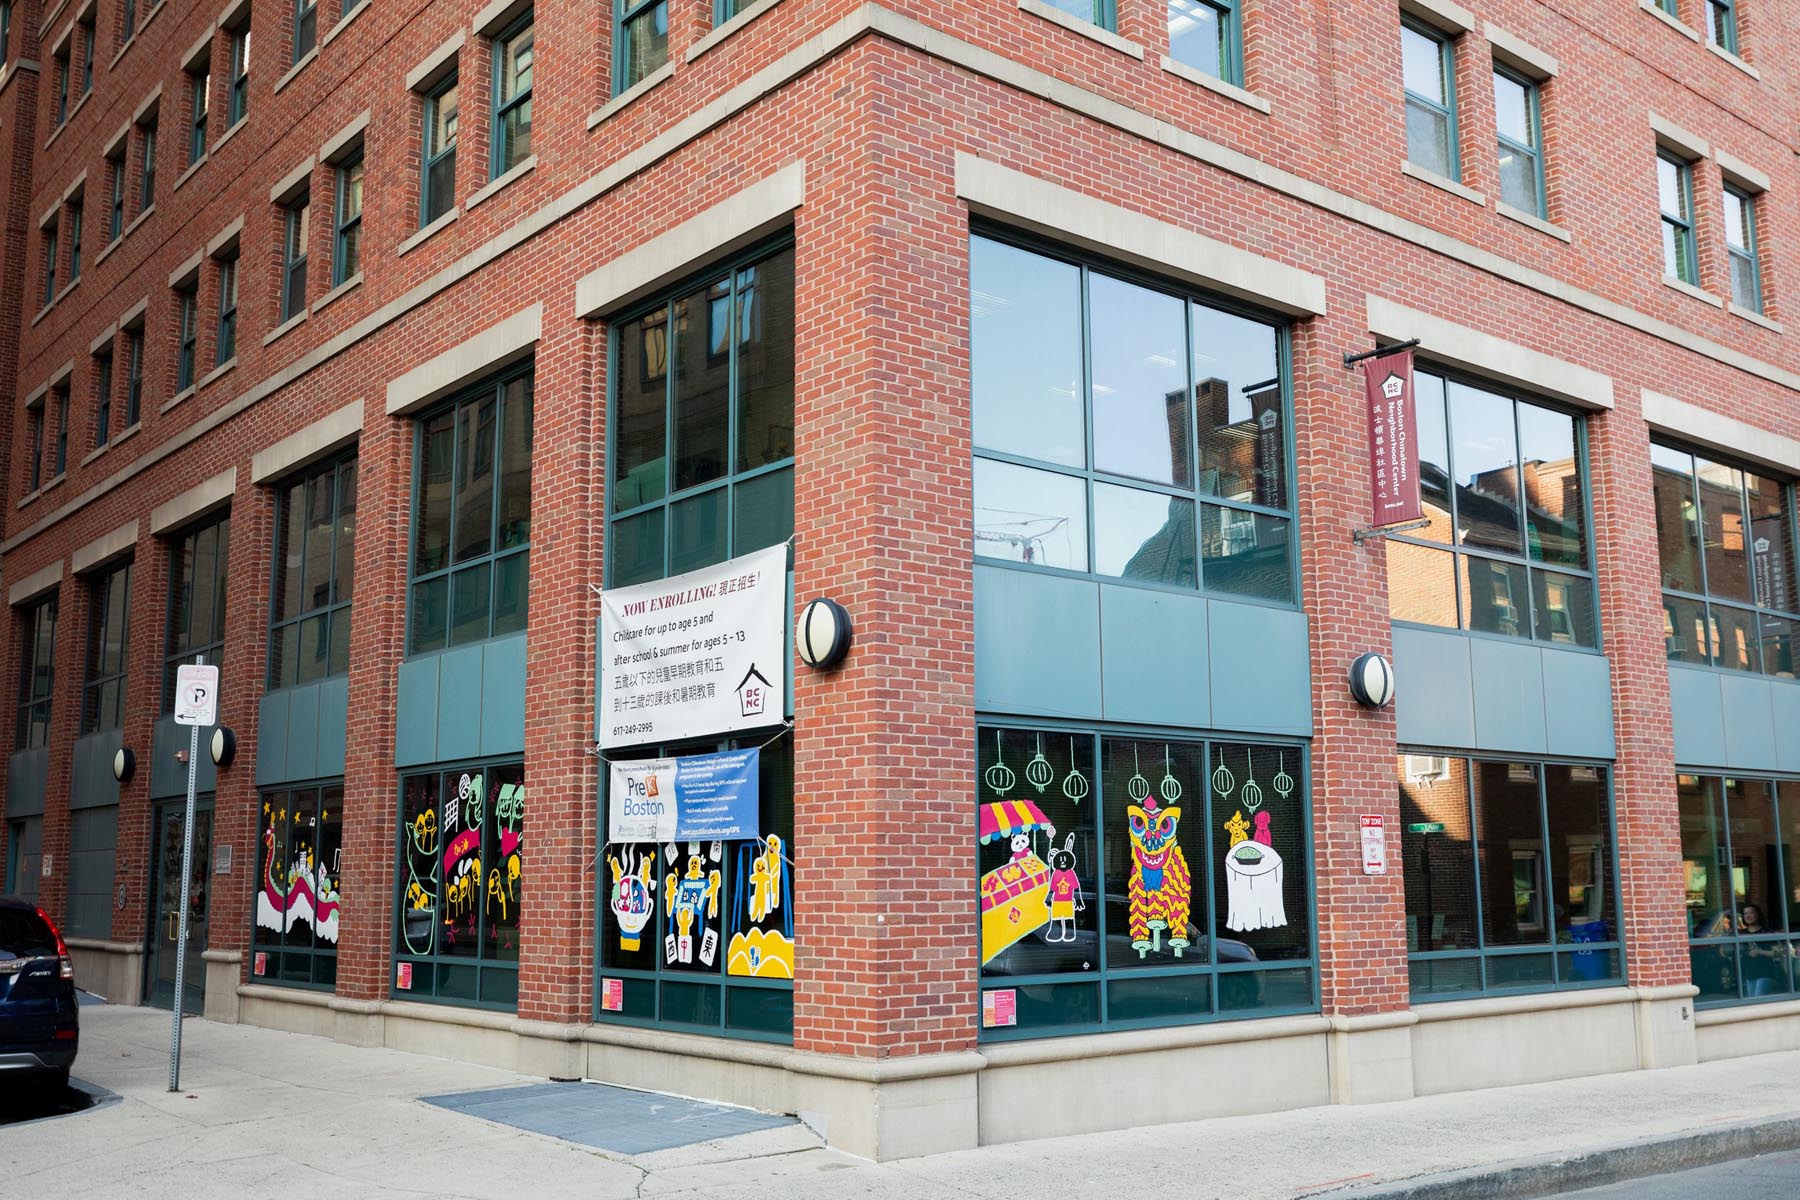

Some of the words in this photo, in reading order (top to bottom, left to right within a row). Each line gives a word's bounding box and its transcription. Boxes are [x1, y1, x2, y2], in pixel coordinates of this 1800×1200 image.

[1396, 399, 1404, 431] Boston
[1387, 401, 1399, 466] Neighborhood
[1398, 431, 1407, 481] Chinatown
[1392, 466, 1400, 496] Center
[621, 600, 650, 617] NOW
[649, 584, 717, 612] ENROLLING!
[644, 624, 656, 637] for
[657, 622, 667, 635] up
[668, 619, 677, 631] to
[678, 617, 692, 632] age
[692, 616, 698, 628] 5
[699, 611, 714, 624] and
[613, 652, 631, 666] after
[632, 647, 653, 663] school
[653, 647, 659, 658] &
[659, 643, 690, 658] summer
[691, 638, 703, 650] for
[703, 636, 721, 649] ages
[722, 633, 728, 645] 5
[735, 630, 746, 643] 13
[746, 688, 760, 698] BC
[746, 697, 760, 708] NC
[613, 722, 653, 736] 617-249-2995
[623, 798, 665, 816] Boston
[680, 938, 688, 960] 中
